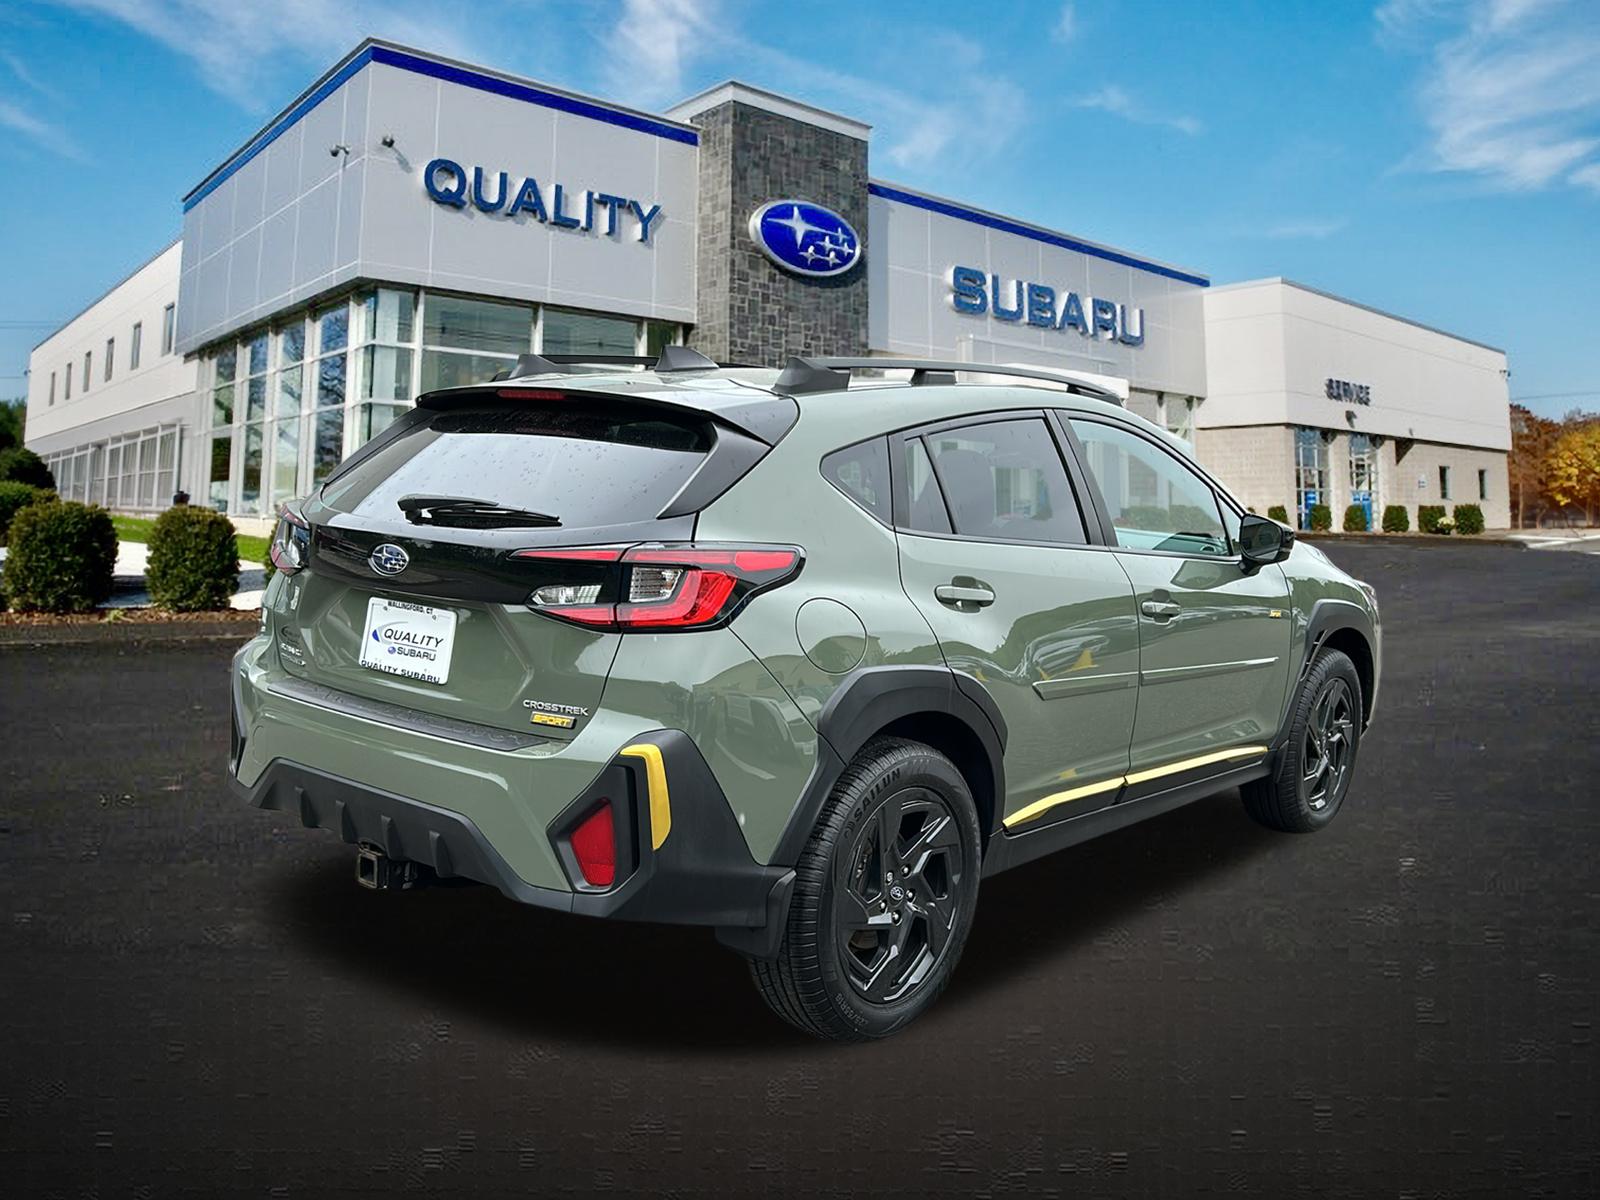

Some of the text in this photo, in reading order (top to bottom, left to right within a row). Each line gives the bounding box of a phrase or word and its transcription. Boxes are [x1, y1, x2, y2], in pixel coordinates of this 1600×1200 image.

[424, 158, 661, 243] QUALITY
[952, 265, 1145, 347] SUBARU
[1324, 377, 1371, 407] SERVICE
[384, 628, 444, 648] QUALITY
[397, 646, 437, 662] SUBARU
[361, 659, 441, 684] QUALITY SUBARU
[522, 699, 589, 716] CROSSTREK
[531, 713, 571, 727] SPORT
[854, 767, 901, 821] SAILUN
